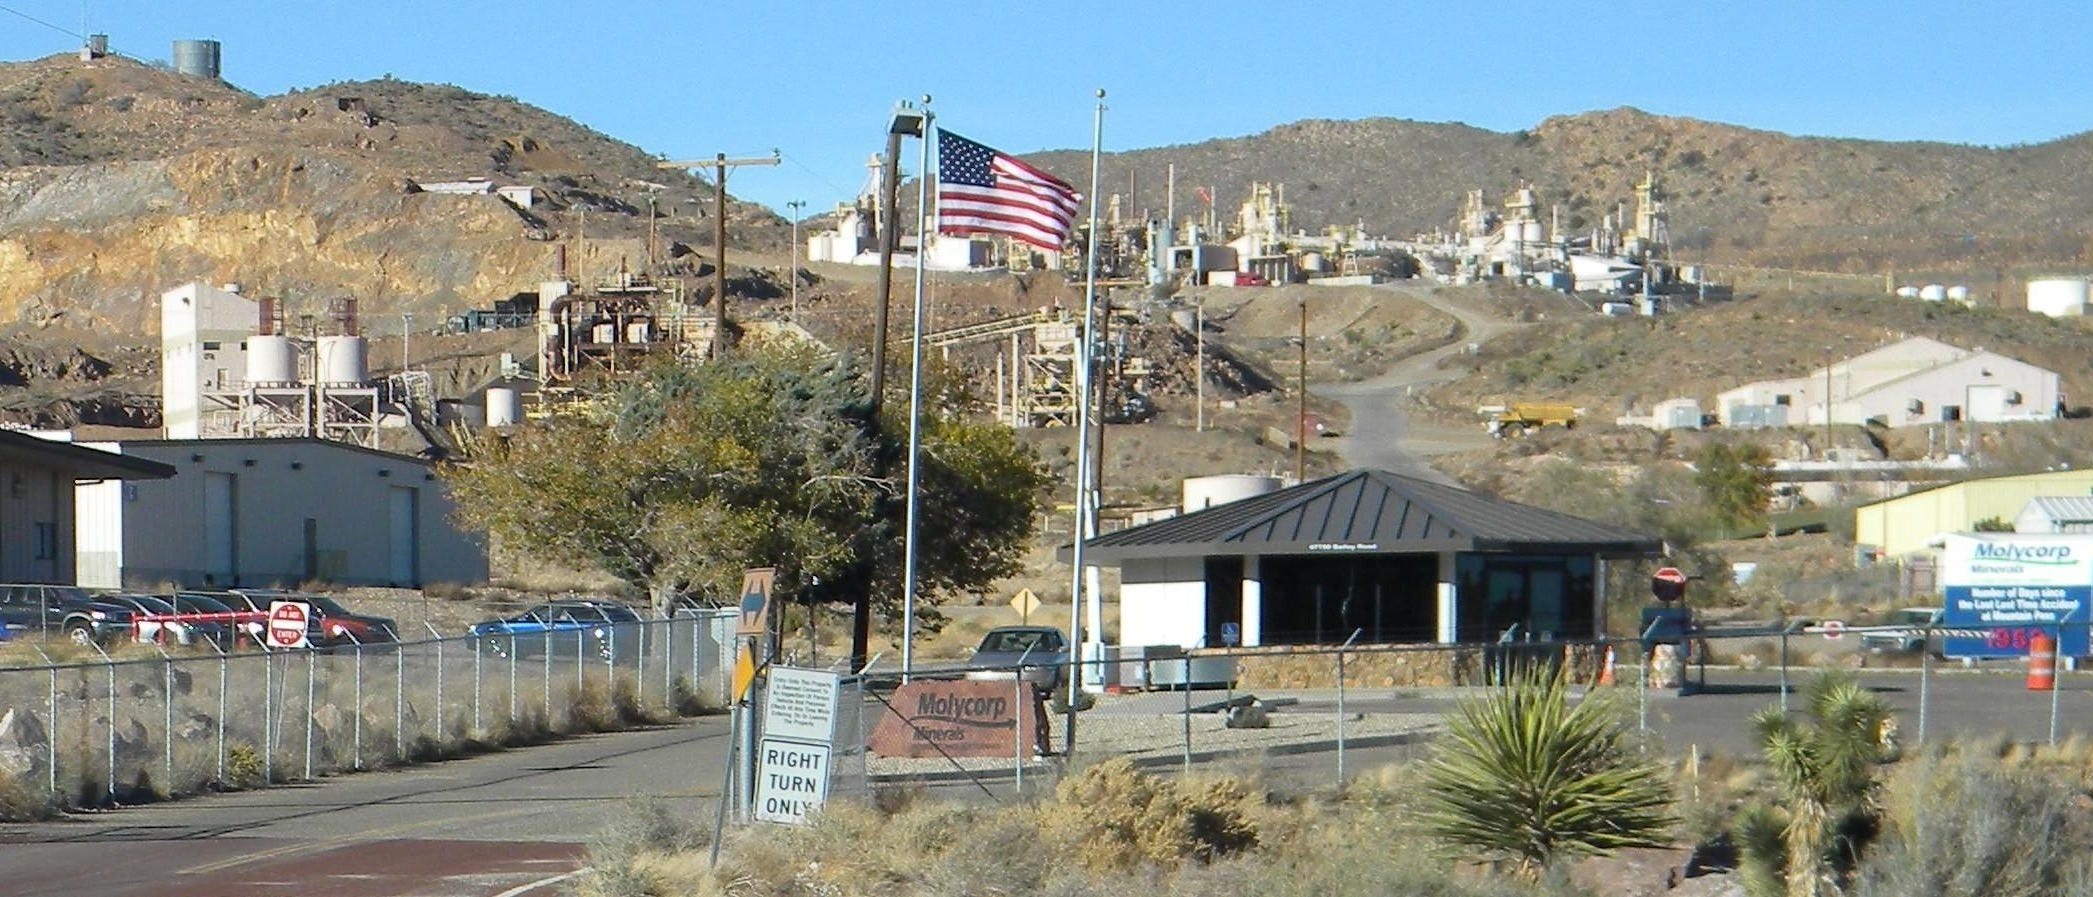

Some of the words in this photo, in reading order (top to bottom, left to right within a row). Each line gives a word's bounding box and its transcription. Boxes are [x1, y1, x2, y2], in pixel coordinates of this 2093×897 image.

[1975, 543, 2071, 561] Molycorp
[1971, 564, 2025, 574] Minerals
[1971, 587, 2006, 598] Number
[2007, 587, 2016, 598] of
[2018, 587, 2040, 600] Days
[1958, 599, 1973, 610] the
[2017, 599, 2039, 610] Time
[2040, 599, 2079, 610] Accident
[279, 610, 288, 618] DO
[288, 611, 300, 619] NOT
[1981, 611, 1991, 621] at
[1992, 611, 2033, 621] Mountain
[2034, 611, 2056, 621] Pass
[276, 630, 298, 639] ENTER
[917, 692, 1007, 720] Molycorp
[912, 726, 965, 741] Minerals
[767, 749, 821, 769] RIGHT
[770, 773, 816, 793] TURN
[766, 797, 813, 816] ONLY
